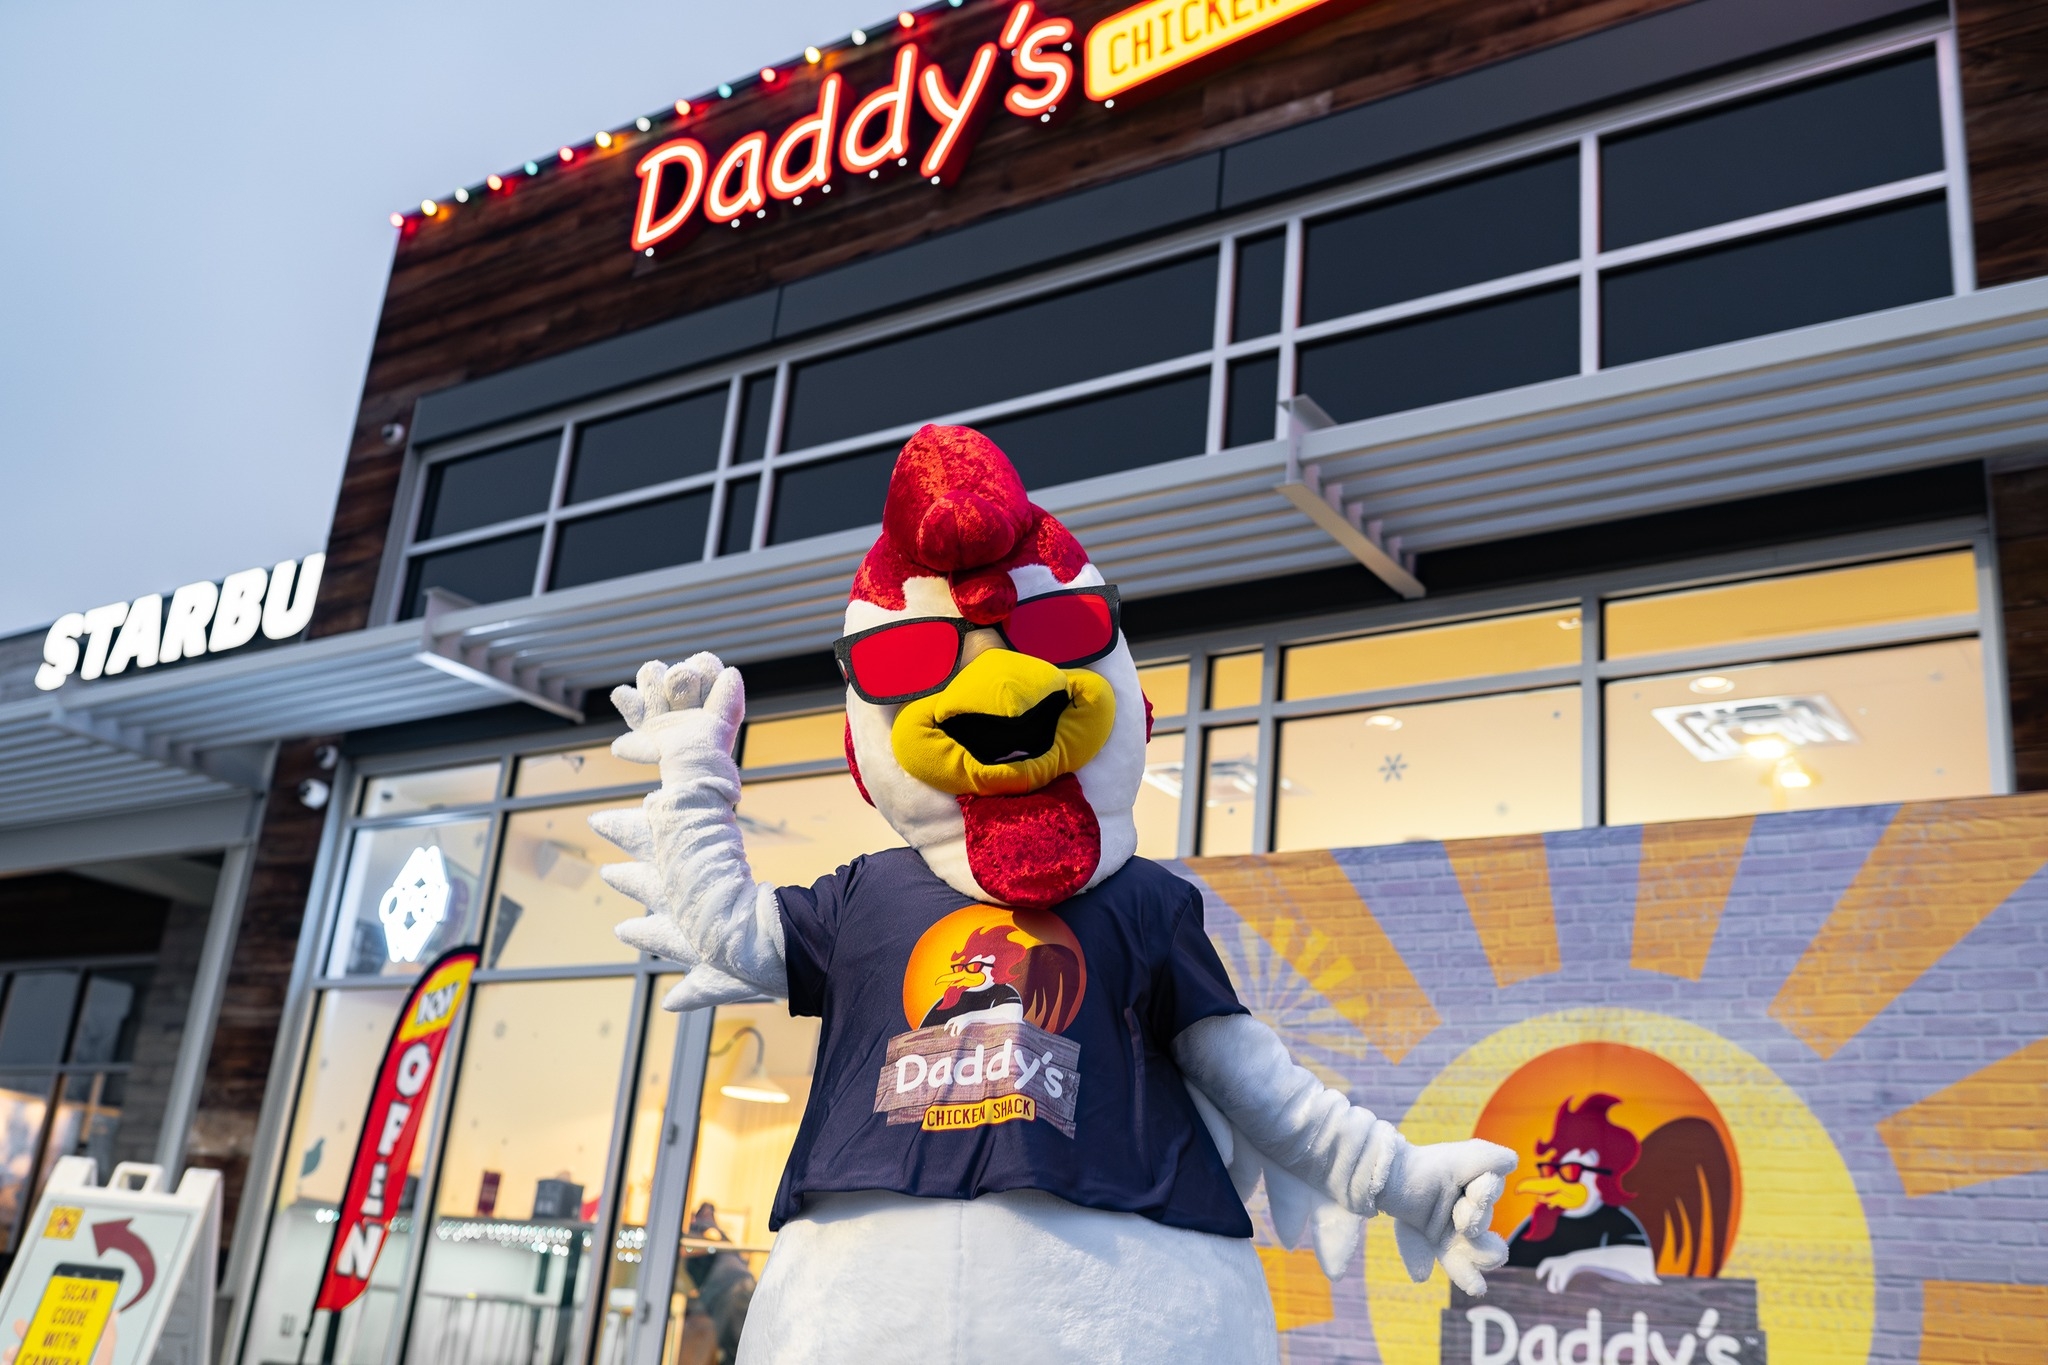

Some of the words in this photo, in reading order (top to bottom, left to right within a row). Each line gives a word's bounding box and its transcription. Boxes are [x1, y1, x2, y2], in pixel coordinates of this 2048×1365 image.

[1109, 0, 1280, 75] CHICK
[632, 0, 1074, 251] Daddy's
[34, 552, 326, 691] STARBU
[895, 1038, 1063, 1099] Daddy's
[927, 1105, 986, 1128] CHICKEN
[993, 1098, 1031, 1119] SHACK
[1466, 1305, 1741, 1365] Daddy's
